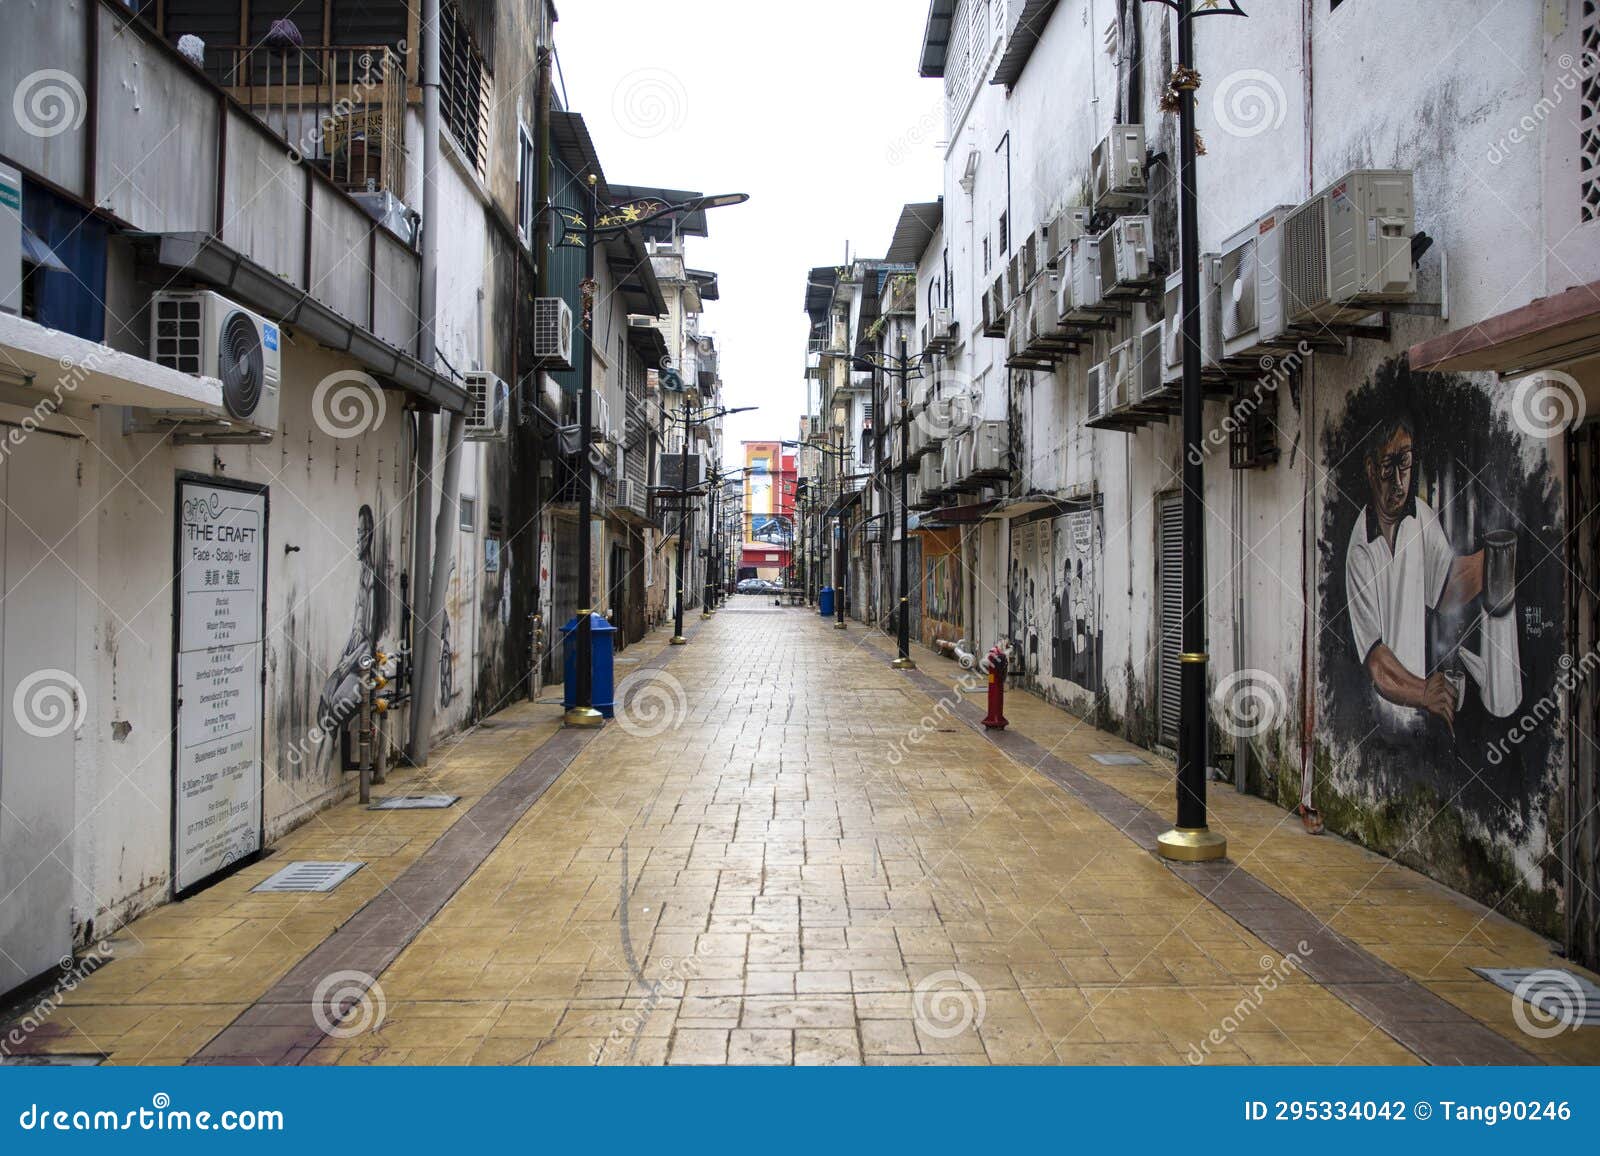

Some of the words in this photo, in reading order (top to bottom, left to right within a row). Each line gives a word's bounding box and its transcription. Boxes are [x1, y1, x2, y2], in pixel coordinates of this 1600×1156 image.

[187, 523, 213, 540] THE
[217, 526, 256, 543] CRAFT
[192, 547, 210, 561] Face
[216, 548, 234, 563] Scalp
[238, 549, 251, 562] Hair
